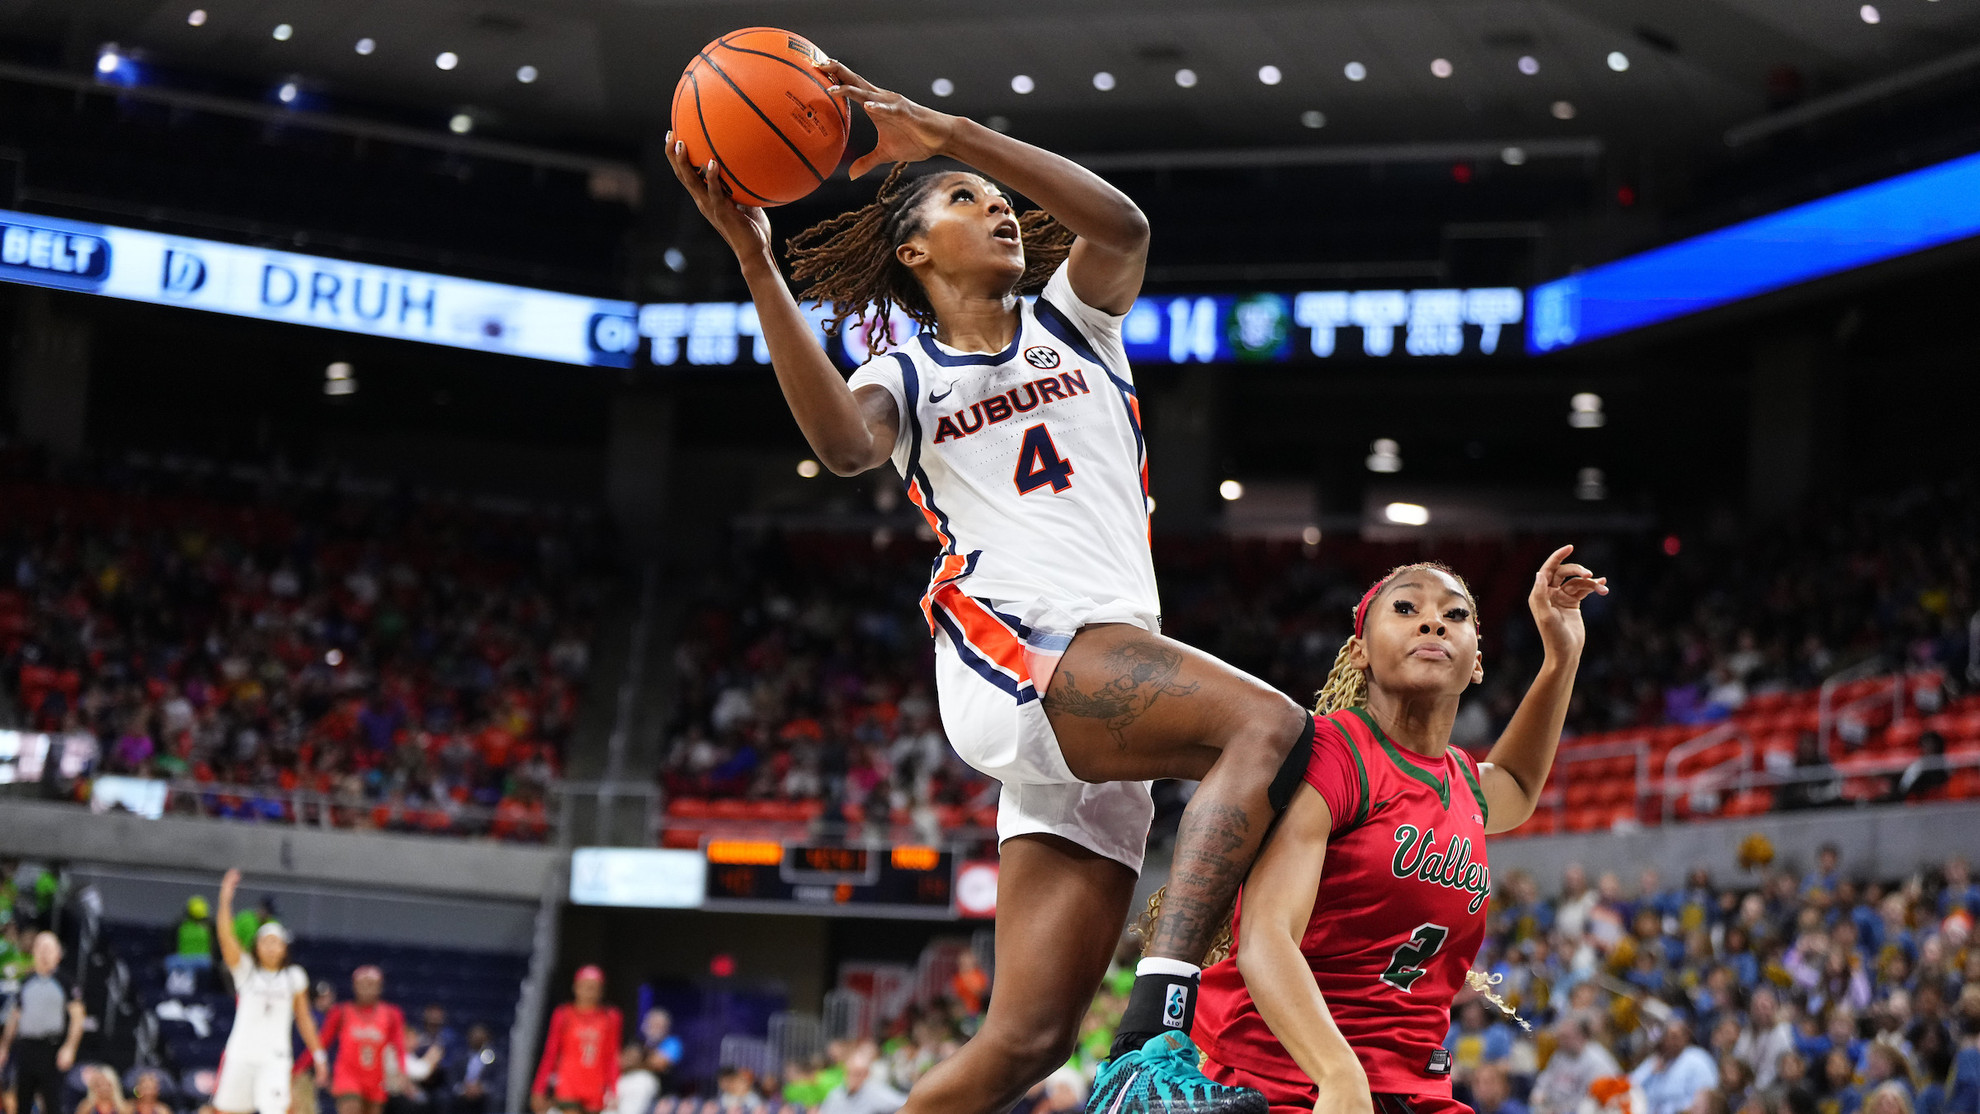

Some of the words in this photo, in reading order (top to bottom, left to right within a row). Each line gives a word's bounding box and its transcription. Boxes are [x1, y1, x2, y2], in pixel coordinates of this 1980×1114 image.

[3, 226, 97, 274] BELT
[261, 264, 436, 327] DRUH
[1027, 346, 1058, 368] SEC
[1167, 297, 1217, 364] 14
[933, 369, 1090, 444] AUBURN
[1013, 422, 1074, 496] 4
[1392, 824, 1491, 914] Valley
[1378, 922, 1449, 994] 2
